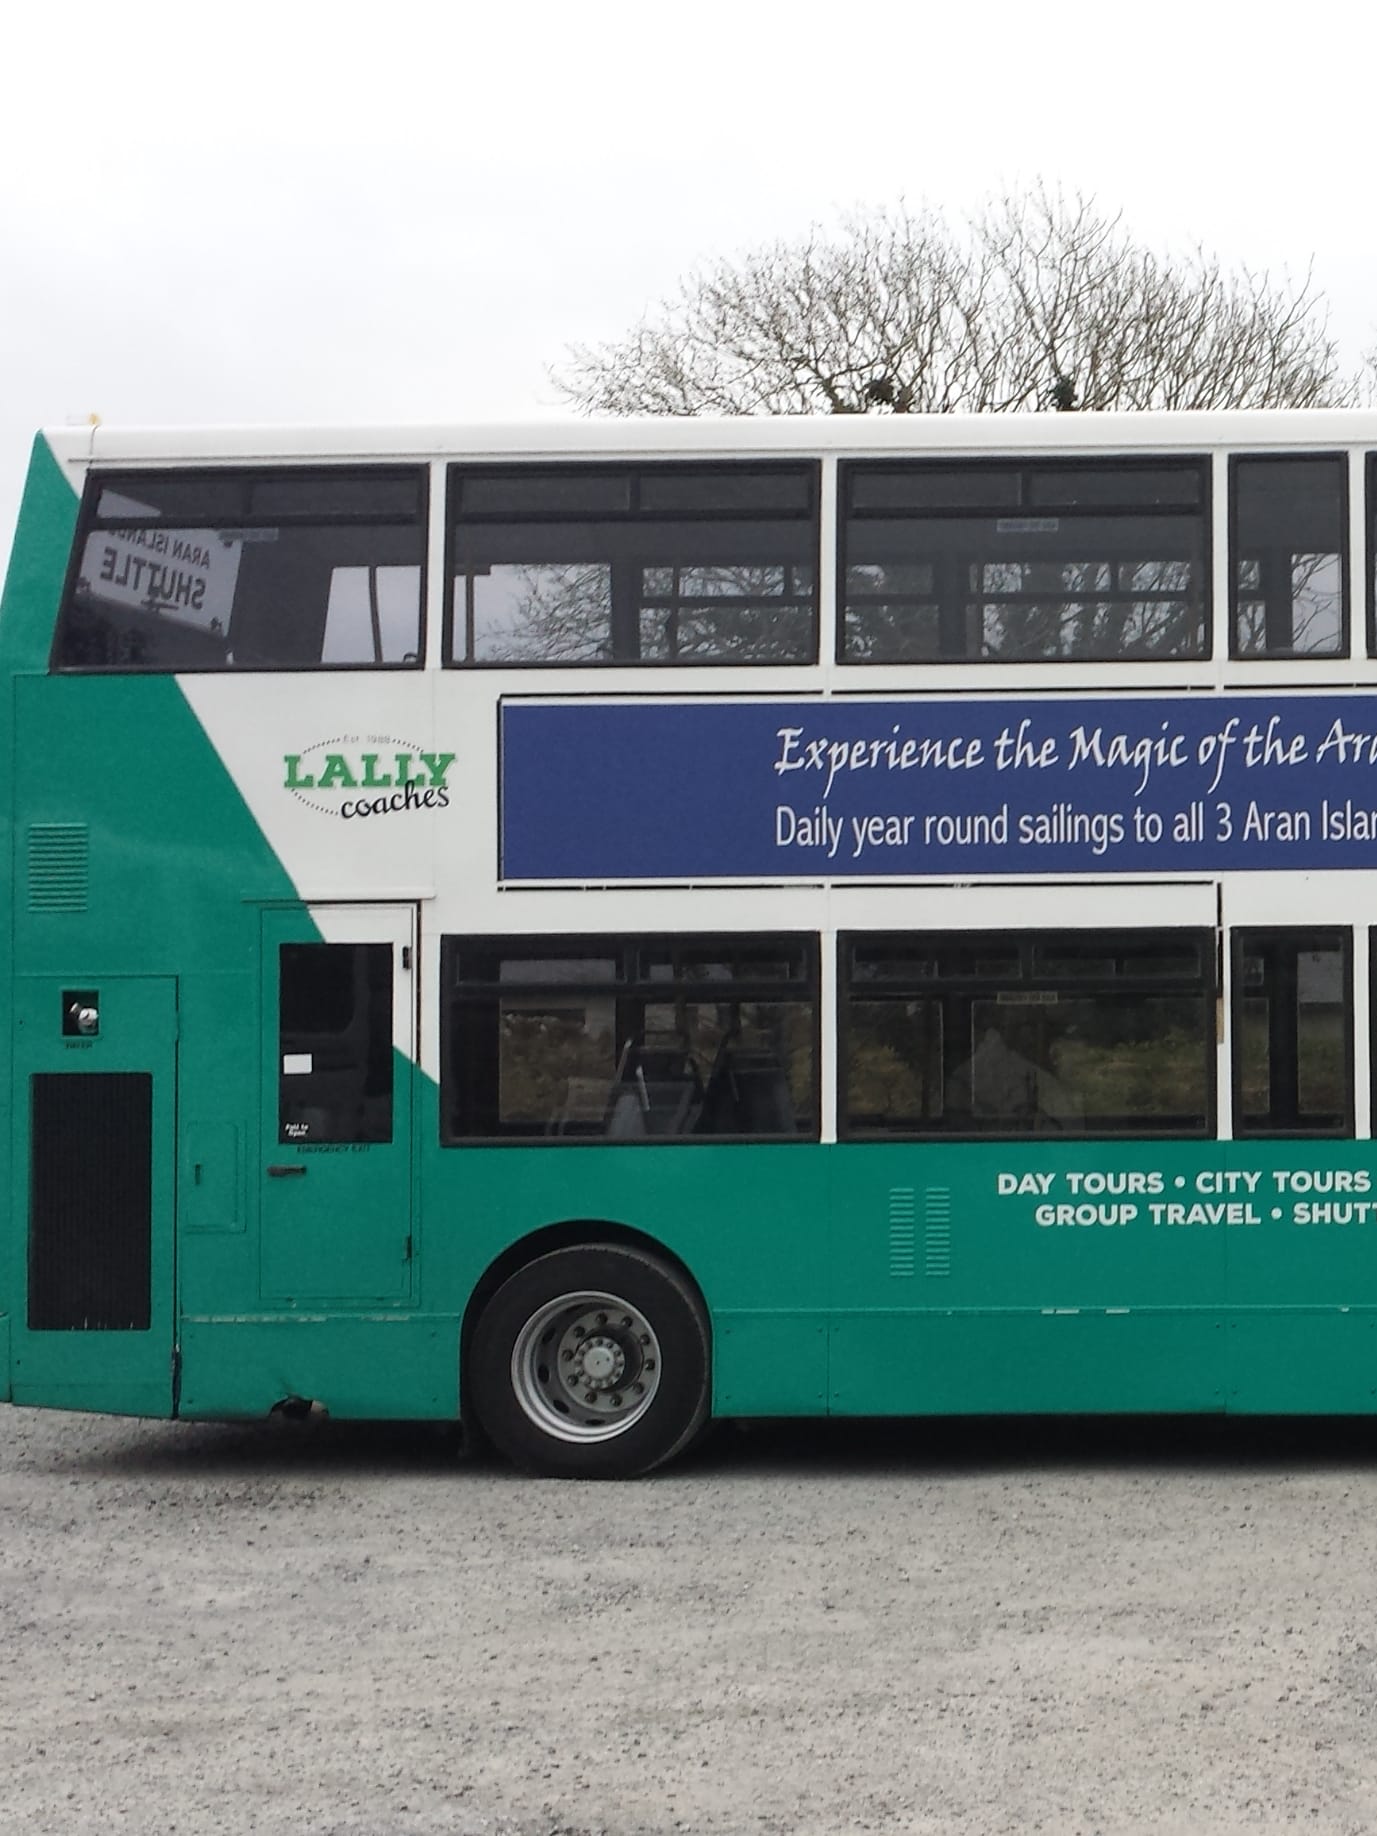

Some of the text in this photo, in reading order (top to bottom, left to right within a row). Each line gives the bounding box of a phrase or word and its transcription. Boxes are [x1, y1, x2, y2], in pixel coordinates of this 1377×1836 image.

[284, 753, 456, 788] LALLY
[774, 724, 985, 799] Experience
[995, 718, 1060, 771] the
[1068, 721, 1188, 796] Magic
[1198, 717, 1241, 794] of
[1243, 715, 1309, 766] the
[340, 779, 451, 820] coaches
[777, 803, 843, 857] Daily
[852, 815, 915, 858] year
[925, 804, 1008, 845] round
[1018, 802, 1125, 855] sailings
[1133, 806, 1163, 843] to
[1173, 799, 1205, 843] all
[1215, 803, 1233, 841] 3
[1243, 803, 1312, 842] Aran
[998, 1173, 1055, 1195] DAY
[1066, 1172, 1164, 1194] TOURS
[1195, 1172, 1262, 1193] CITY
[1272, 1171, 1371, 1193] TOURS
[1035, 1204, 1138, 1226] GROUP
[1148, 1203, 1261, 1225] TRAVEL
